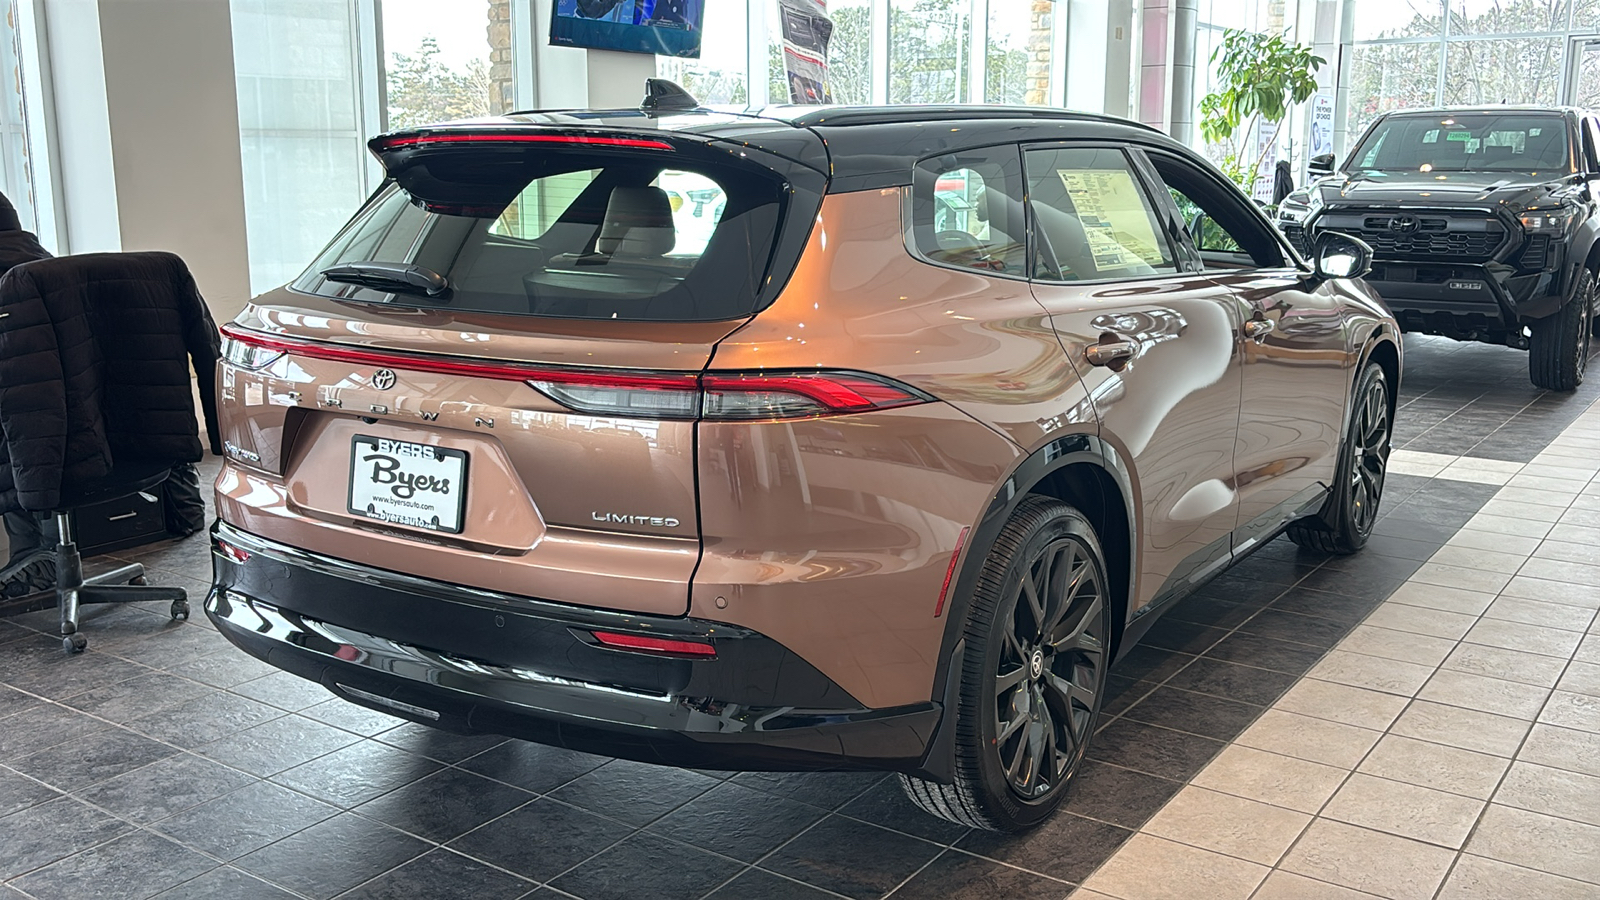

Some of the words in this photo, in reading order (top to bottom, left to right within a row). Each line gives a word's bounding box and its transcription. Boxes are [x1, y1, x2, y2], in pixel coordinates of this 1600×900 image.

[378, 439, 435, 460] BYERS
[363, 454, 450, 499] Byers
[372, 495, 434, 511] www.byersauto.com
[366, 511, 437, 530] www.byersauto.com
[592, 511, 680, 527] LIMITED
